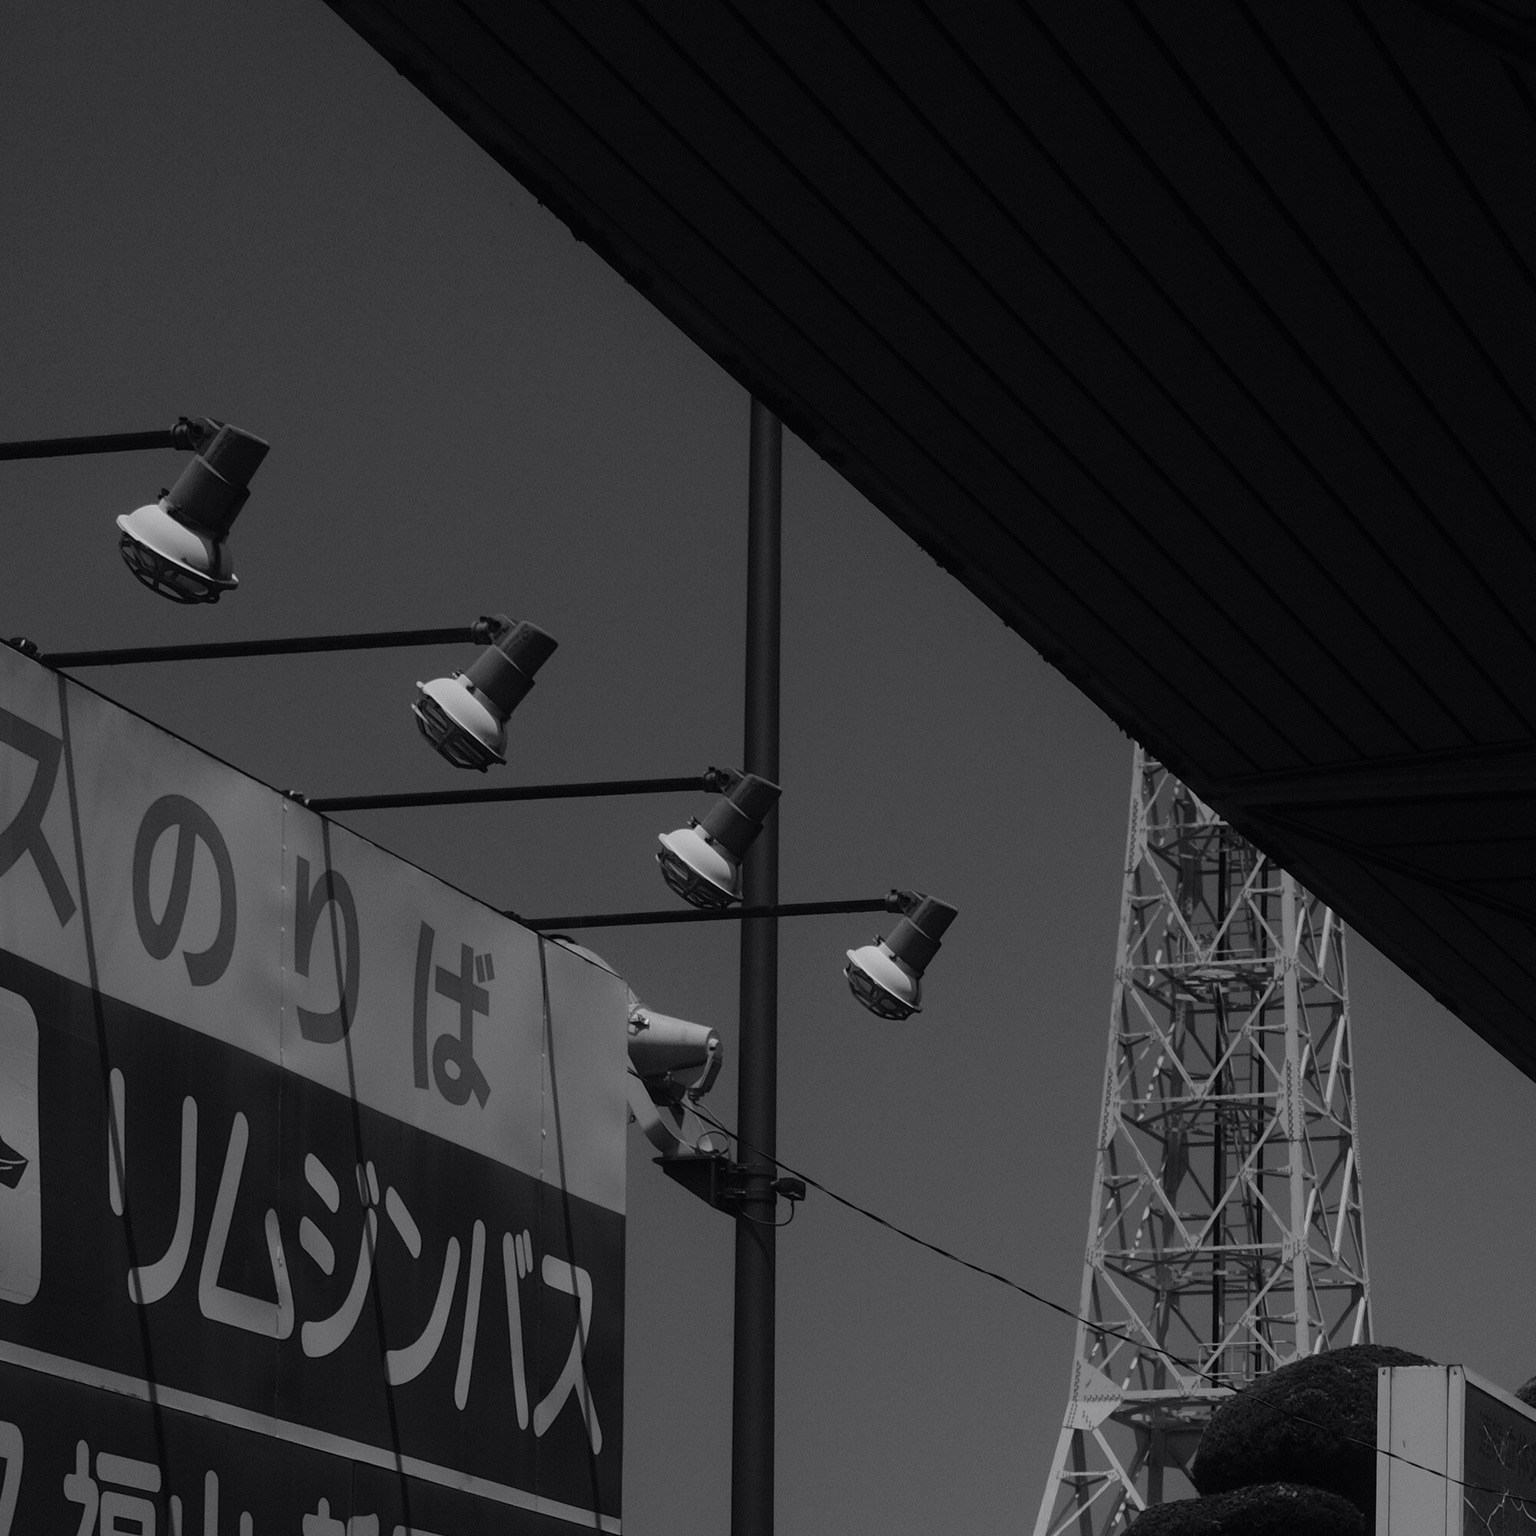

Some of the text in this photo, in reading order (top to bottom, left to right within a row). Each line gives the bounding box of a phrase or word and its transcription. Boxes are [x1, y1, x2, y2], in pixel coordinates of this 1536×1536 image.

[108, 1067, 603, 1456] リムジンバス
